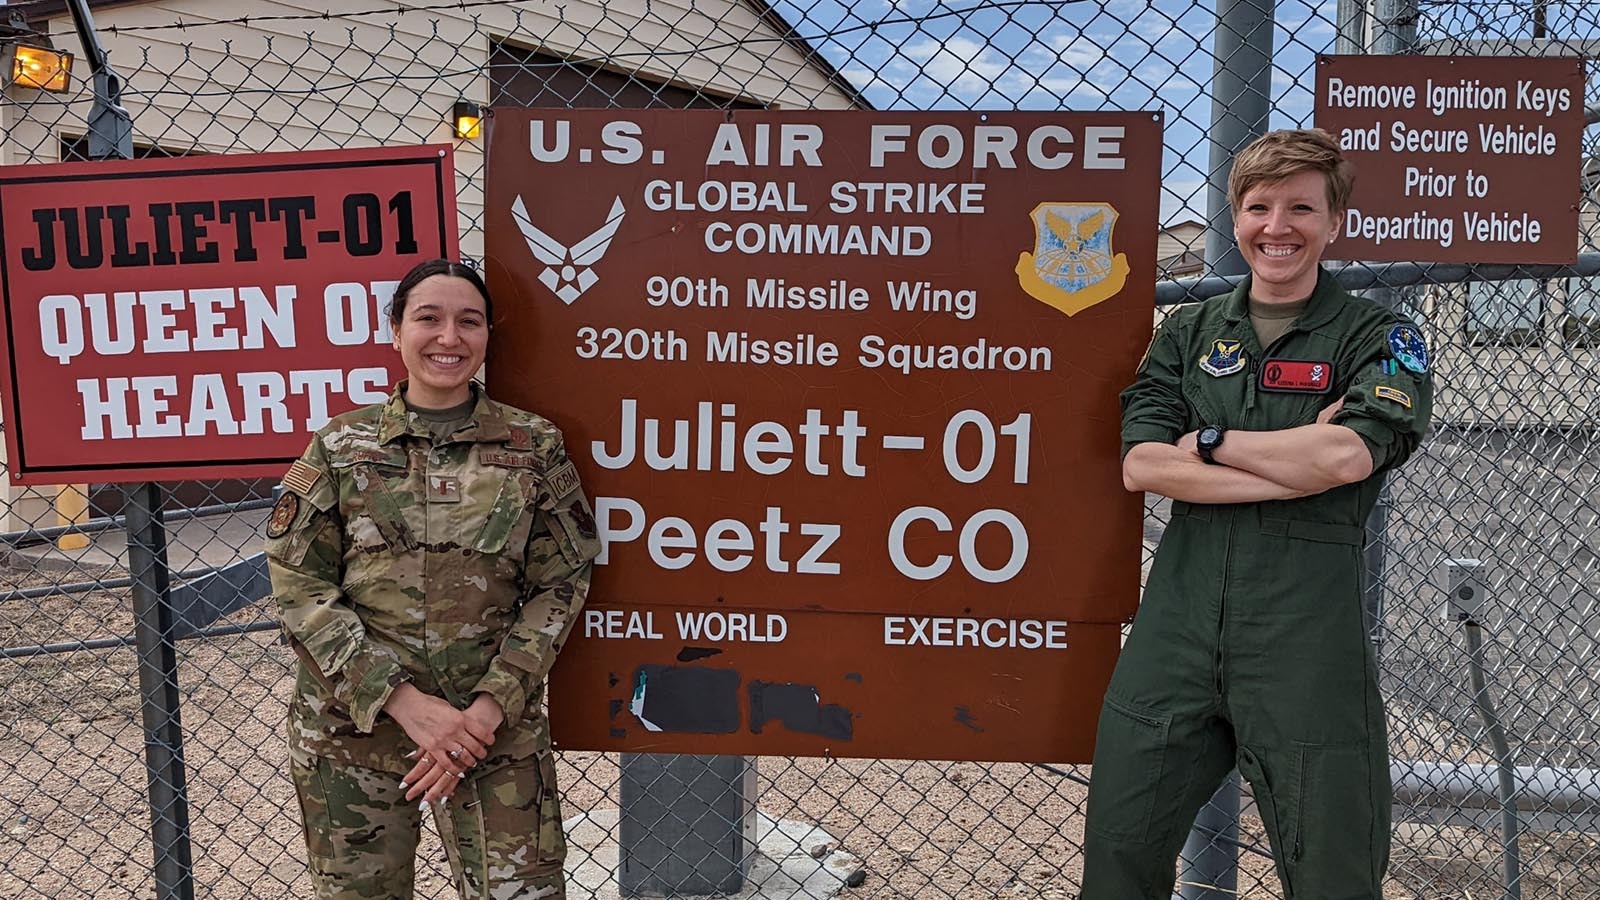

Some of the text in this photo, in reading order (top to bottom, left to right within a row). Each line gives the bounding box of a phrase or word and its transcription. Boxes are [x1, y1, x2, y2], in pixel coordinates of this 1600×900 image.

[1328, 78, 1570, 116] Remove Ignition Keys
[531, 120, 1125, 169] U.S. AIR FORCE
[1340, 121, 1556, 155] and Secure Vehicle
[645, 180, 985, 213] GLOBAL STRIKE
[1406, 167, 1488, 197] Prior to
[22, 191, 417, 271] JULIETT-01
[705, 222, 931, 255] COMMAND
[1347, 209, 1540, 247] Departing Vehicle
[647, 276, 976, 319] 90th Missile Wing
[39, 285, 296, 364] QUEEN
[576, 327, 1051, 374] 320th Missile Squadron
[77, 367, 389, 440] HEARTS
[552, 468, 579, 495] ICBM
[595, 497, 1028, 582] Peetz CO
[586, 611, 1067, 648] REAL WORLD EXERCISE
